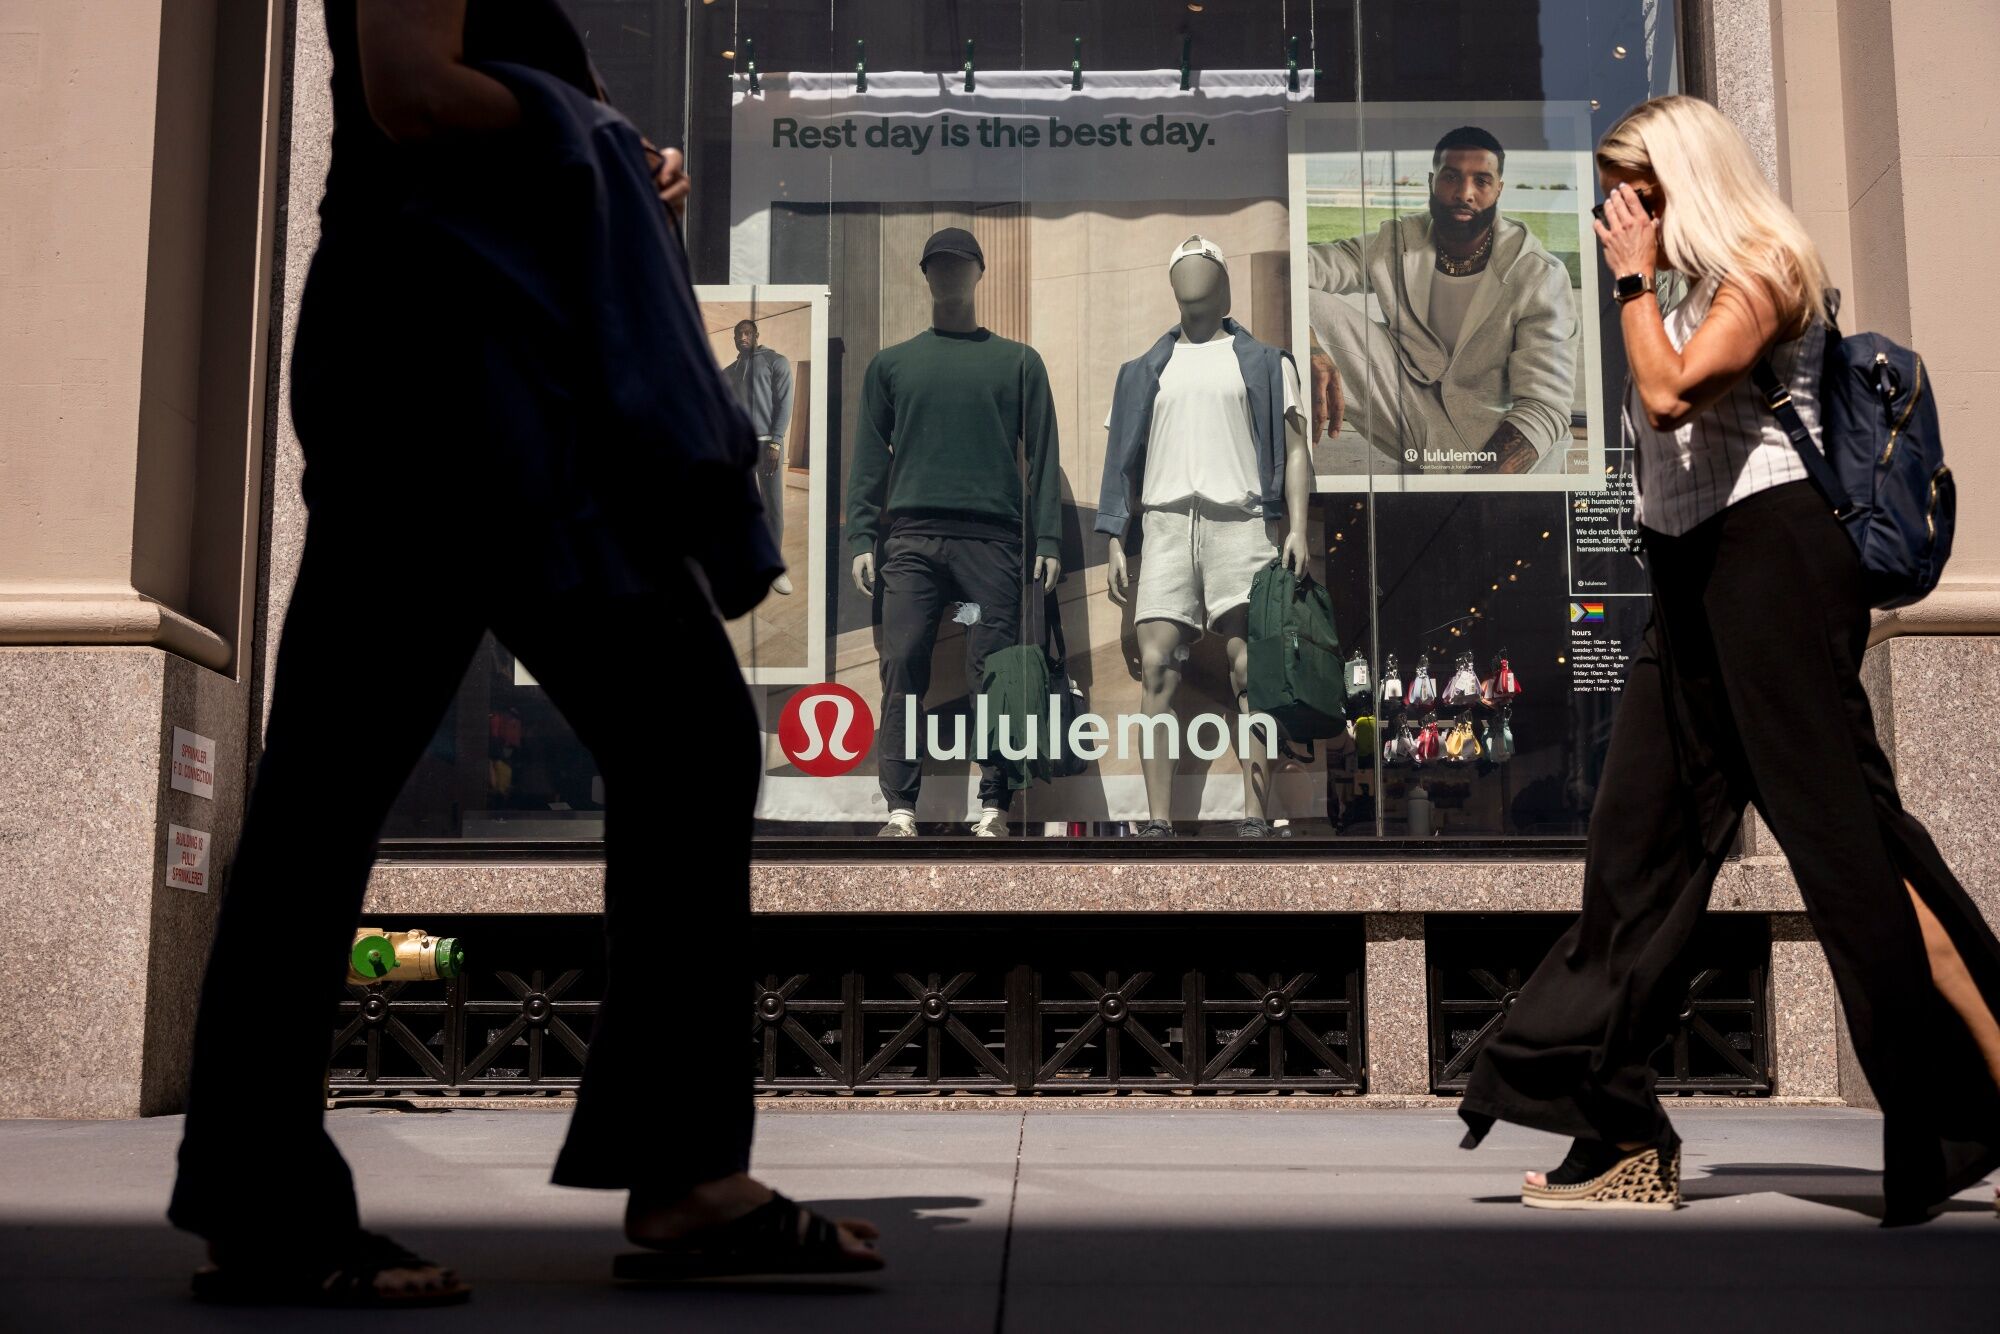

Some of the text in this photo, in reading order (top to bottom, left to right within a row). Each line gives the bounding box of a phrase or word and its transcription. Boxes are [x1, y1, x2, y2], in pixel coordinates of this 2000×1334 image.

[772, 114, 1215, 155] Rest day is the best day.
[1423, 448, 1497, 462] lululemon
[1577, 545, 1619, 553] harassment,
[905, 694, 1278, 762] lululemon
[181, 744, 207, 765] SPRINKLER
[184, 764, 213, 786] CONNECTION
[176, 831, 204, 851] BUILDING IS
[181, 851, 196, 867] FULLY
[172, 866, 204, 886] SPRINKLERED
